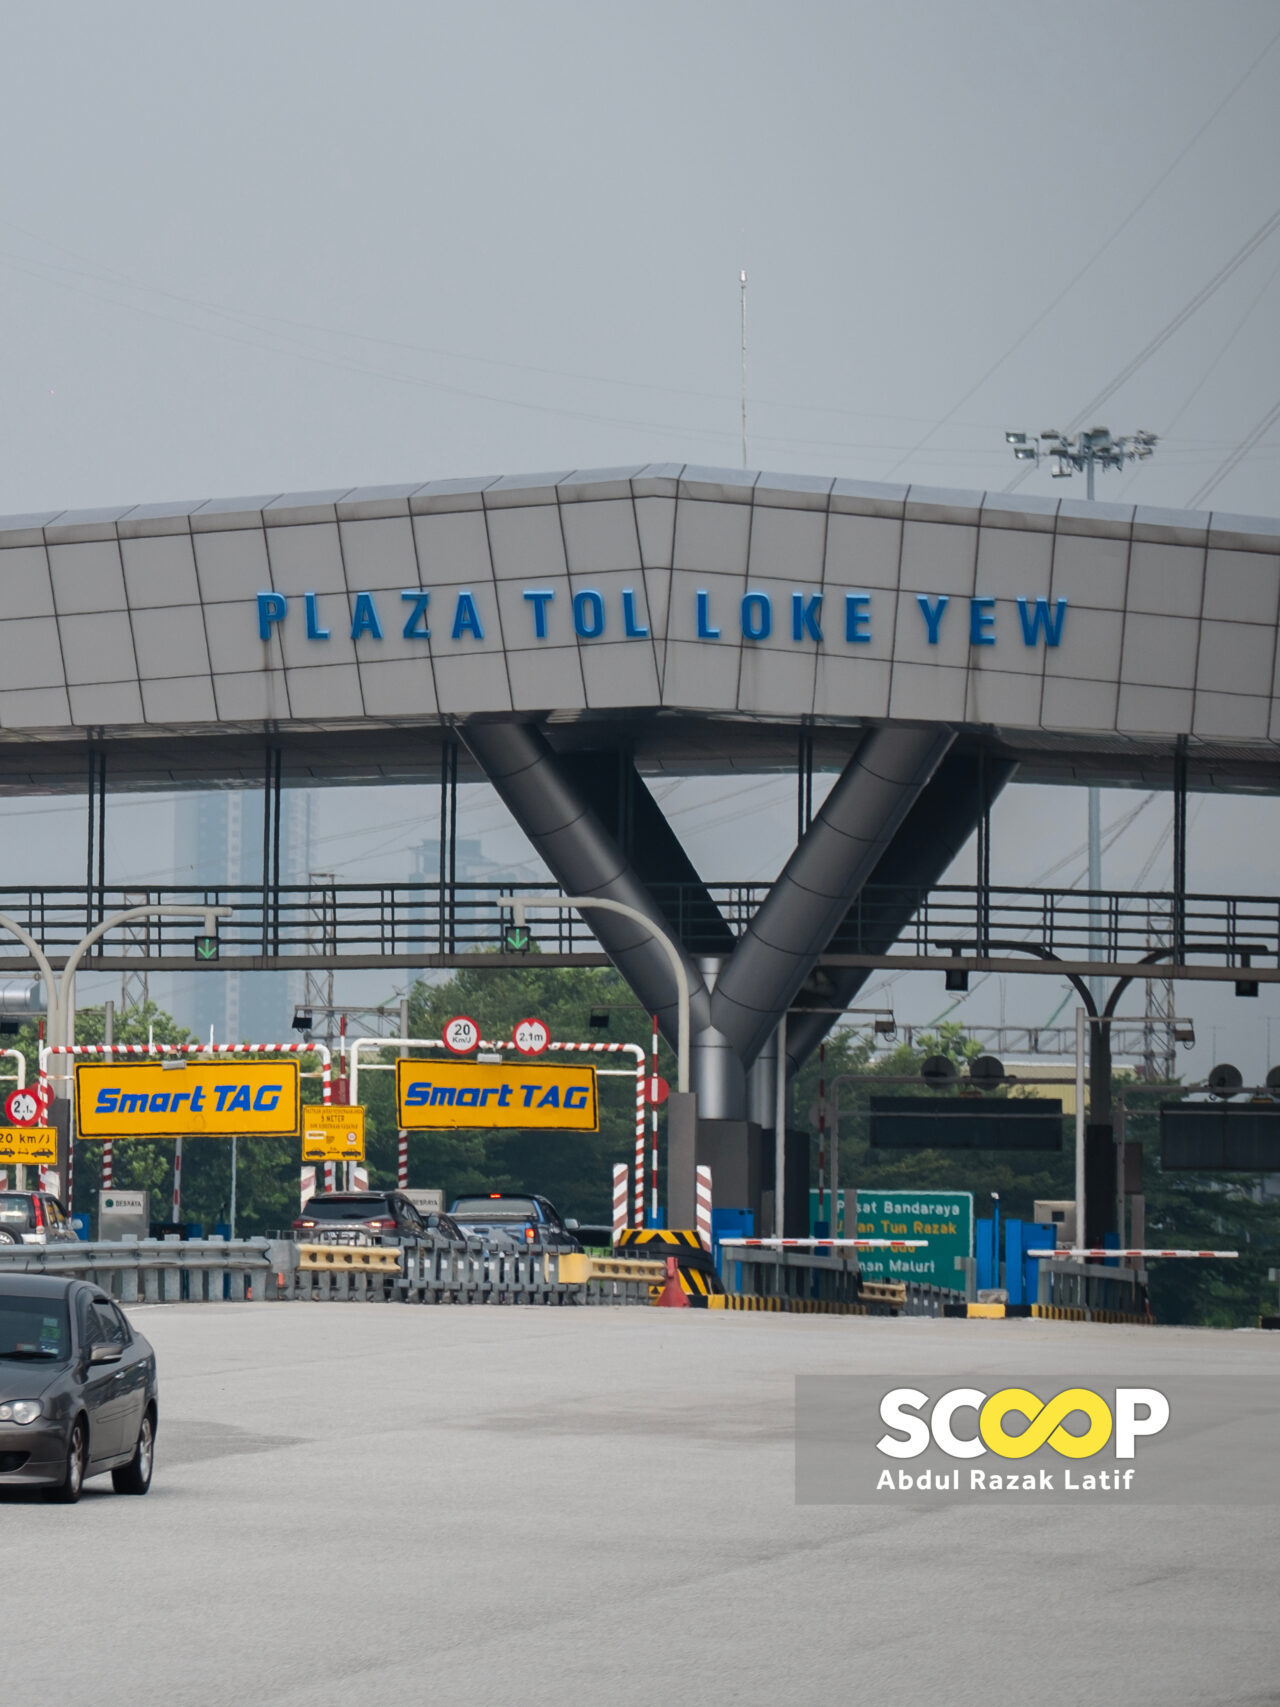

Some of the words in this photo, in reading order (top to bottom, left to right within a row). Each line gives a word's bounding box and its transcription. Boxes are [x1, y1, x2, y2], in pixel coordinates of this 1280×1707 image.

[256, 591, 484, 641] PLAZA
[523, 589, 649, 640] TOL
[696, 590, 872, 643] LOKE
[916, 594, 1068, 647] YEW
[454, 1024, 471, 1036] 20
[520, 1032, 544, 1042] 2.1m
[95, 1085, 206, 1113] Smart
[214, 1085, 282, 1112] TAG
[404, 1082, 513, 1107] Smart
[520, 1085, 590, 1109] TAG
[837, 1200, 877, 1215] Psat
[884, 1201, 960, 1217] Bandaraya
[881, 1220, 907, 1234] Tun
[913, 1221, 957, 1235] Razak
